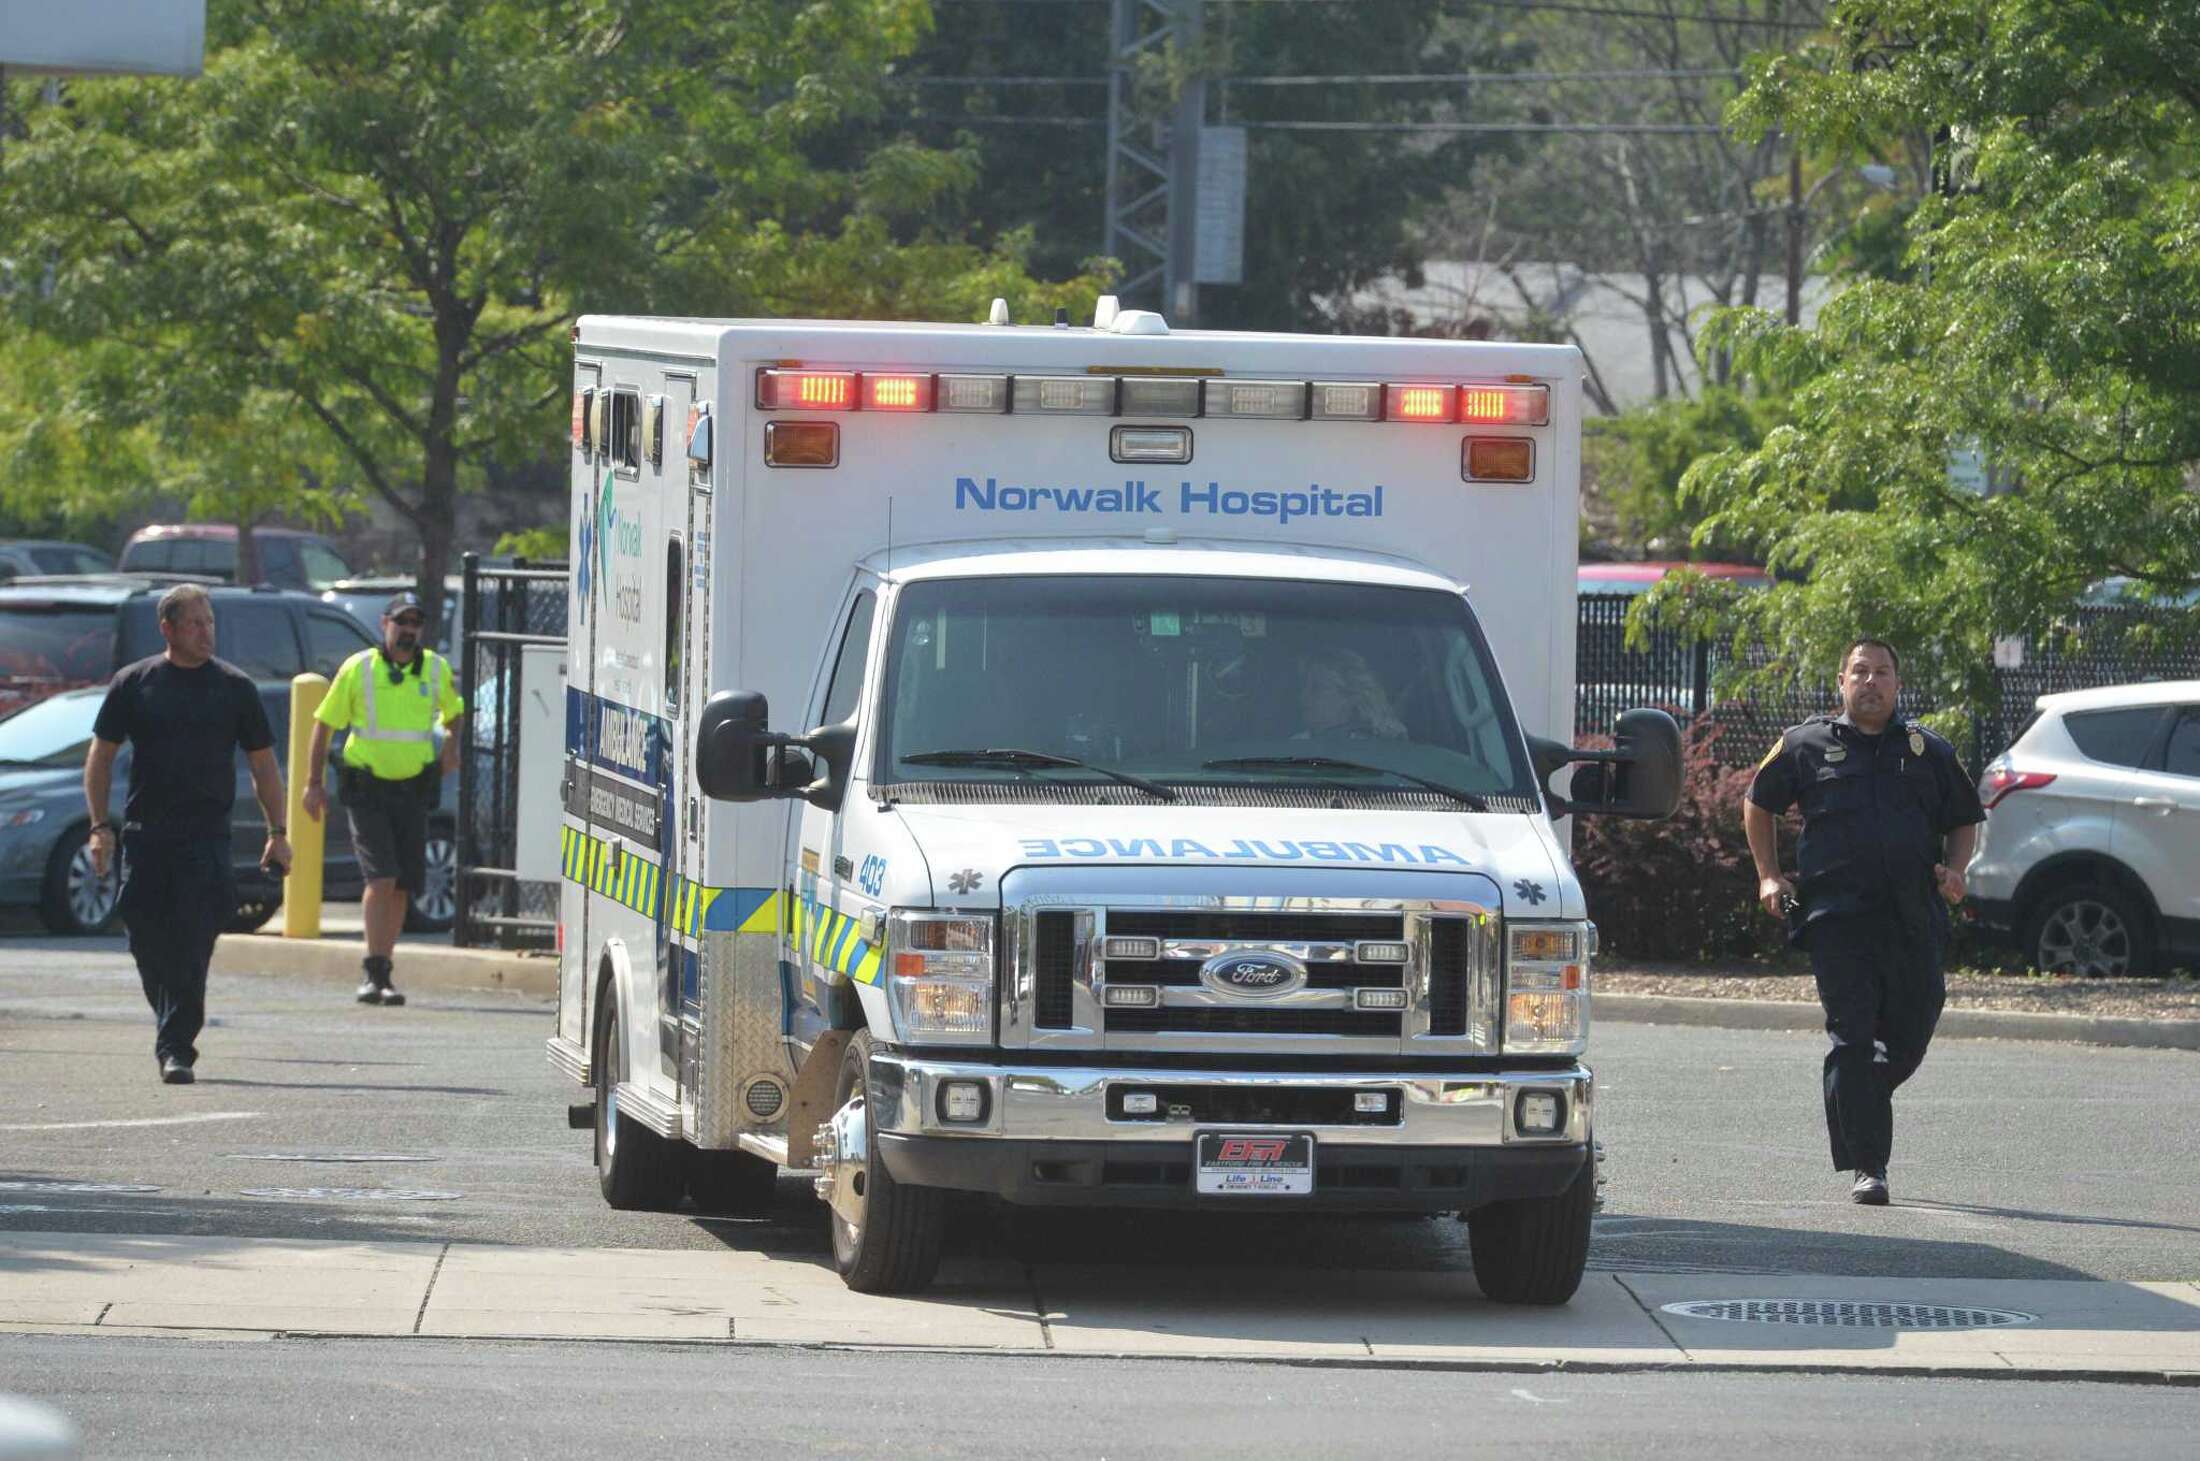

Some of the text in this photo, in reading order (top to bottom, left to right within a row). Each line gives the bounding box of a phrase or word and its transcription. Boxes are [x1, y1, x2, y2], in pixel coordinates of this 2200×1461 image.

[955, 477, 1384, 525] Norwalk Hospital
[600, 706, 647, 771] AMBULANCE
[858, 853, 888, 897] 403
[1231, 962, 1282, 985] Ford
